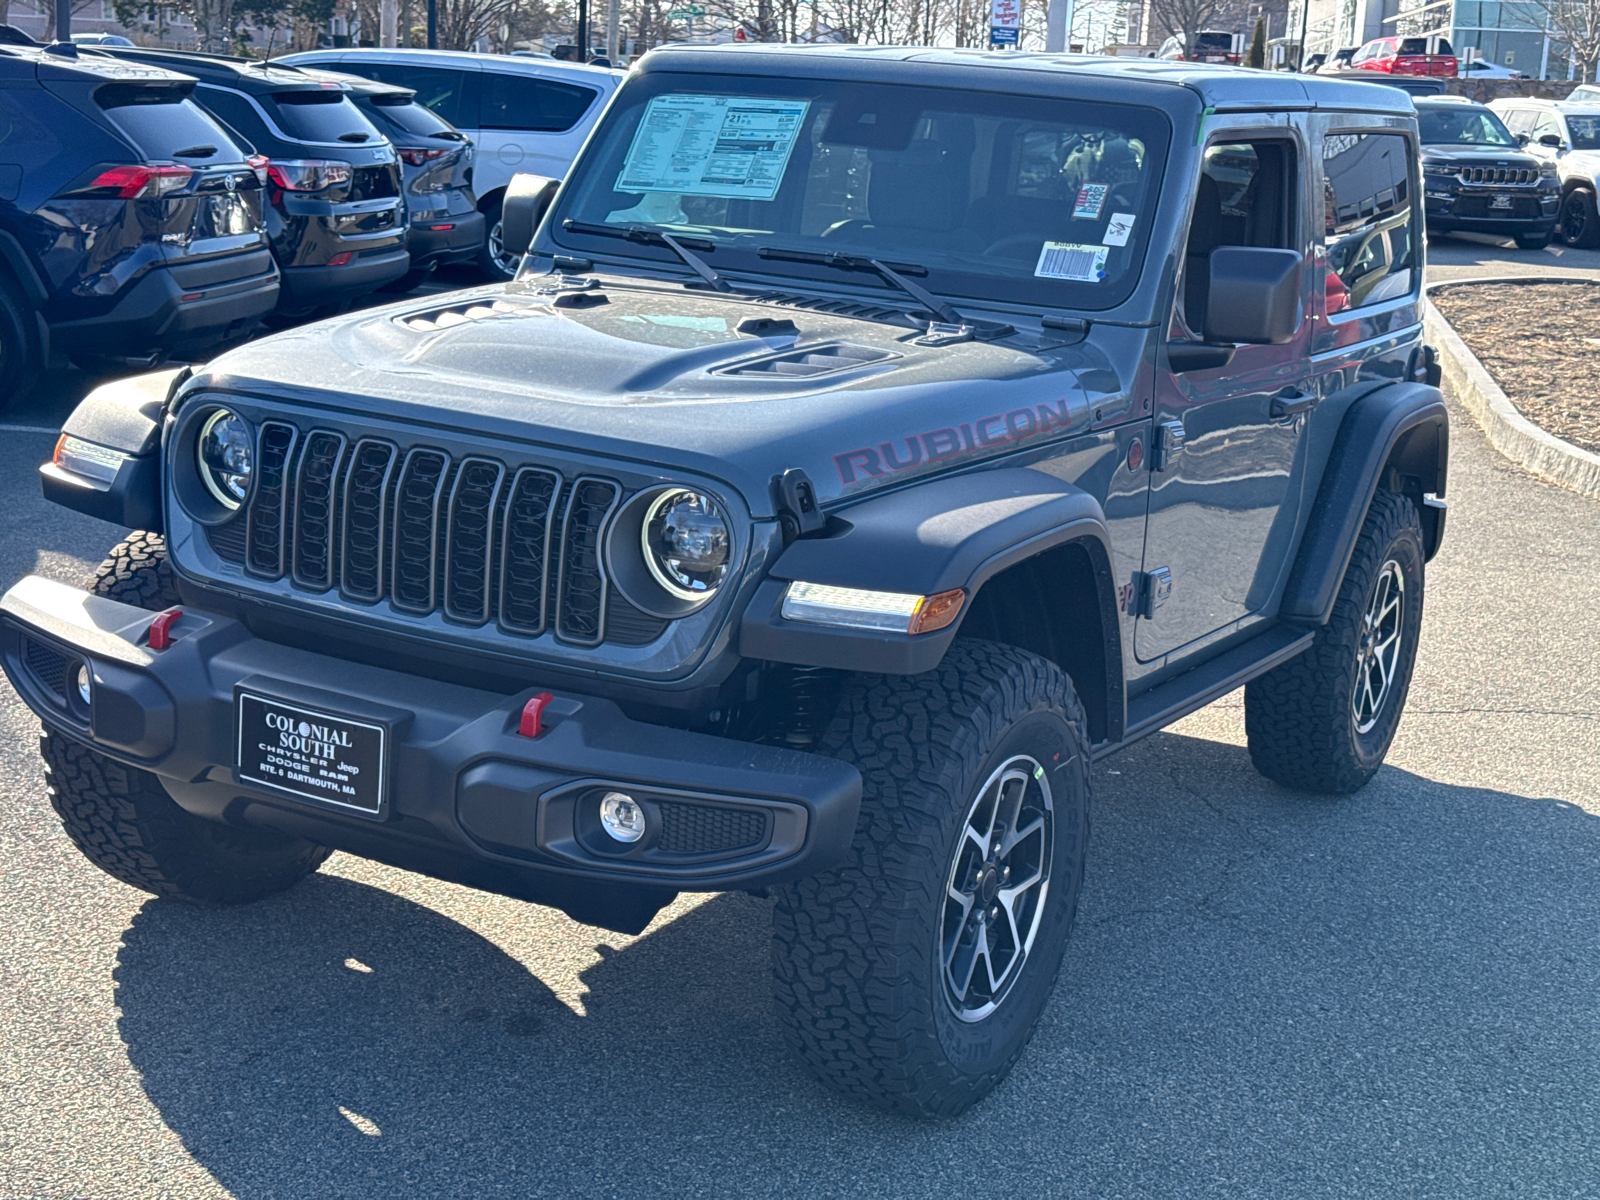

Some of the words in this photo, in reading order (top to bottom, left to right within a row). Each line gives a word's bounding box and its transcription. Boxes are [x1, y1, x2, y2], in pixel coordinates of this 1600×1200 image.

[832, 398, 1072, 486] RUBICON
[265, 712, 353, 747] COLONIAL
[258, 743, 328, 767] CHRYSLER
[337, 761, 359, 775] Jeep
[279, 732, 336, 760] SOUTH
[260, 763, 277, 775] RTE.
[287, 771, 341, 793] DARTMOUTH,
[342, 785, 356, 795] MA
[266, 754, 310, 773] DODGE
[319, 769, 349, 782] RAM
